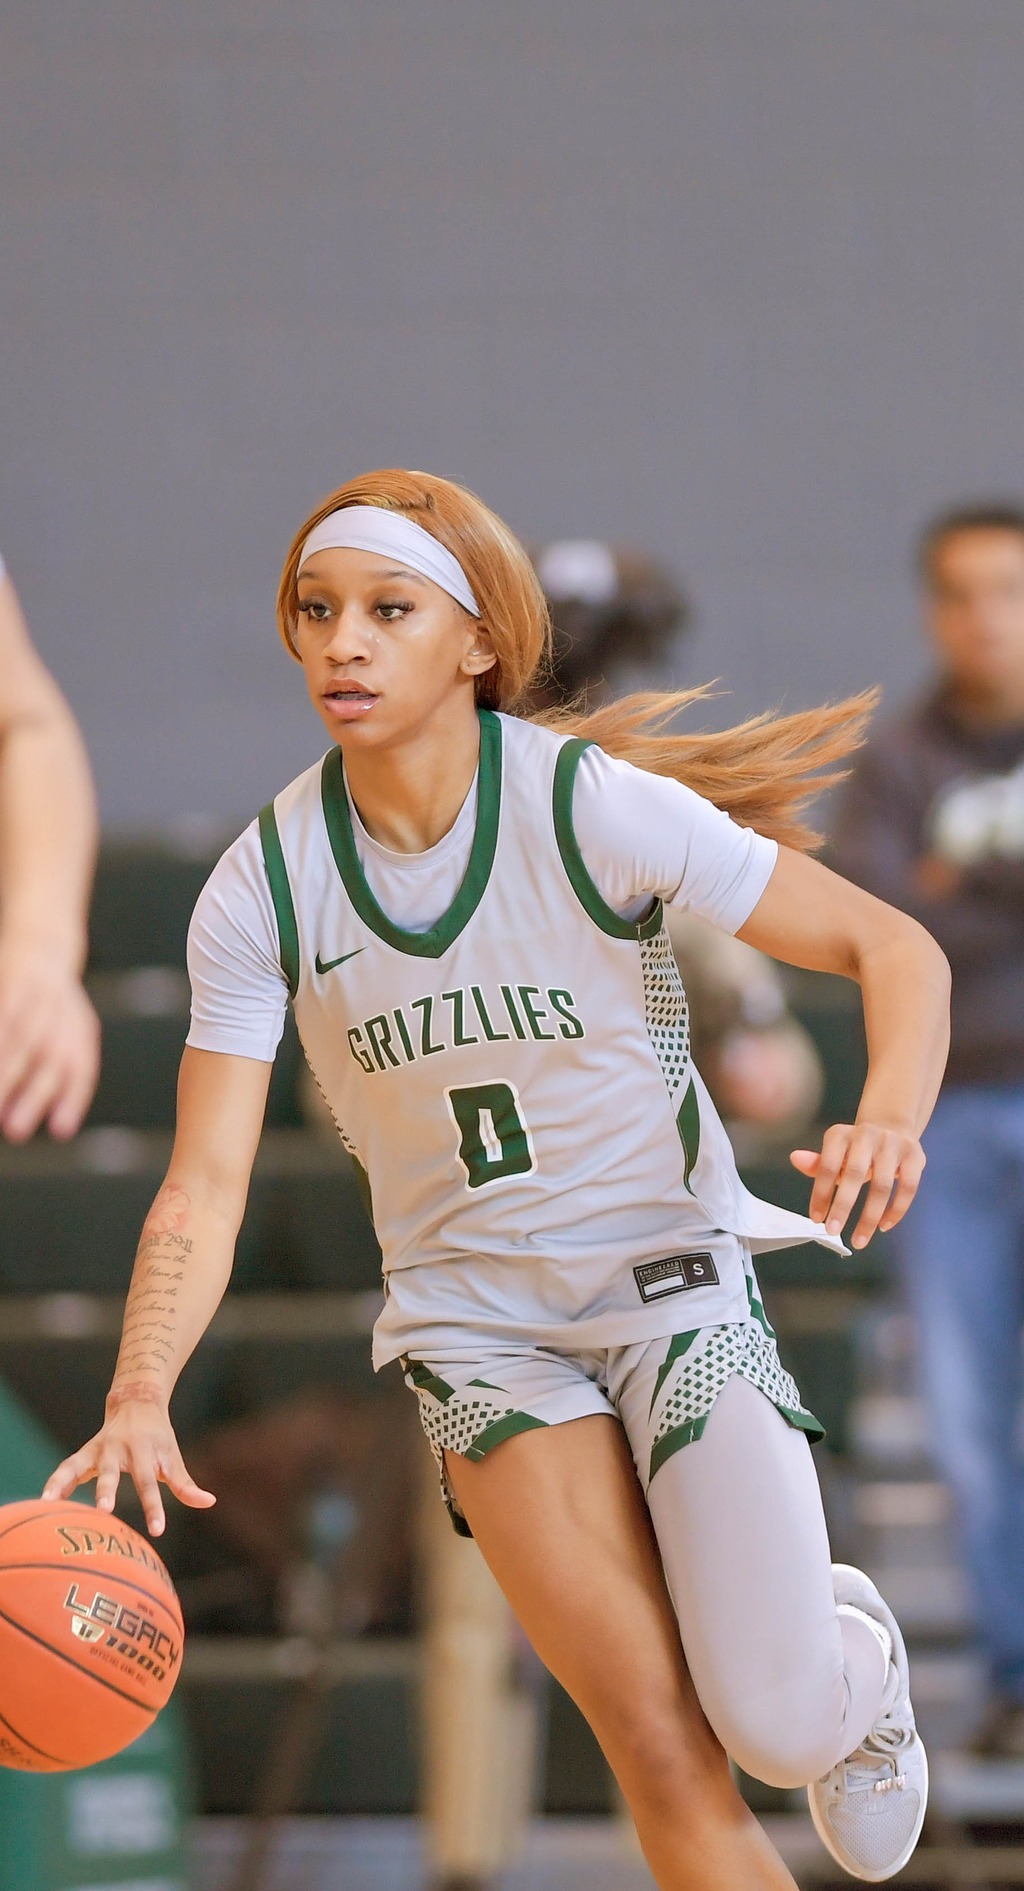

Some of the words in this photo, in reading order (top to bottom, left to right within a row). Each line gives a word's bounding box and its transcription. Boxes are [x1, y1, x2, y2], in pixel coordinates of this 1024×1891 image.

[347, 983, 585, 1074] GRIZZLIES
[444, 1079, 537, 1192] 0
[692, 1263, 705, 1276] S
[56, 1526, 176, 1597] SPALD
[63, 1581, 180, 1668] LEGACY
